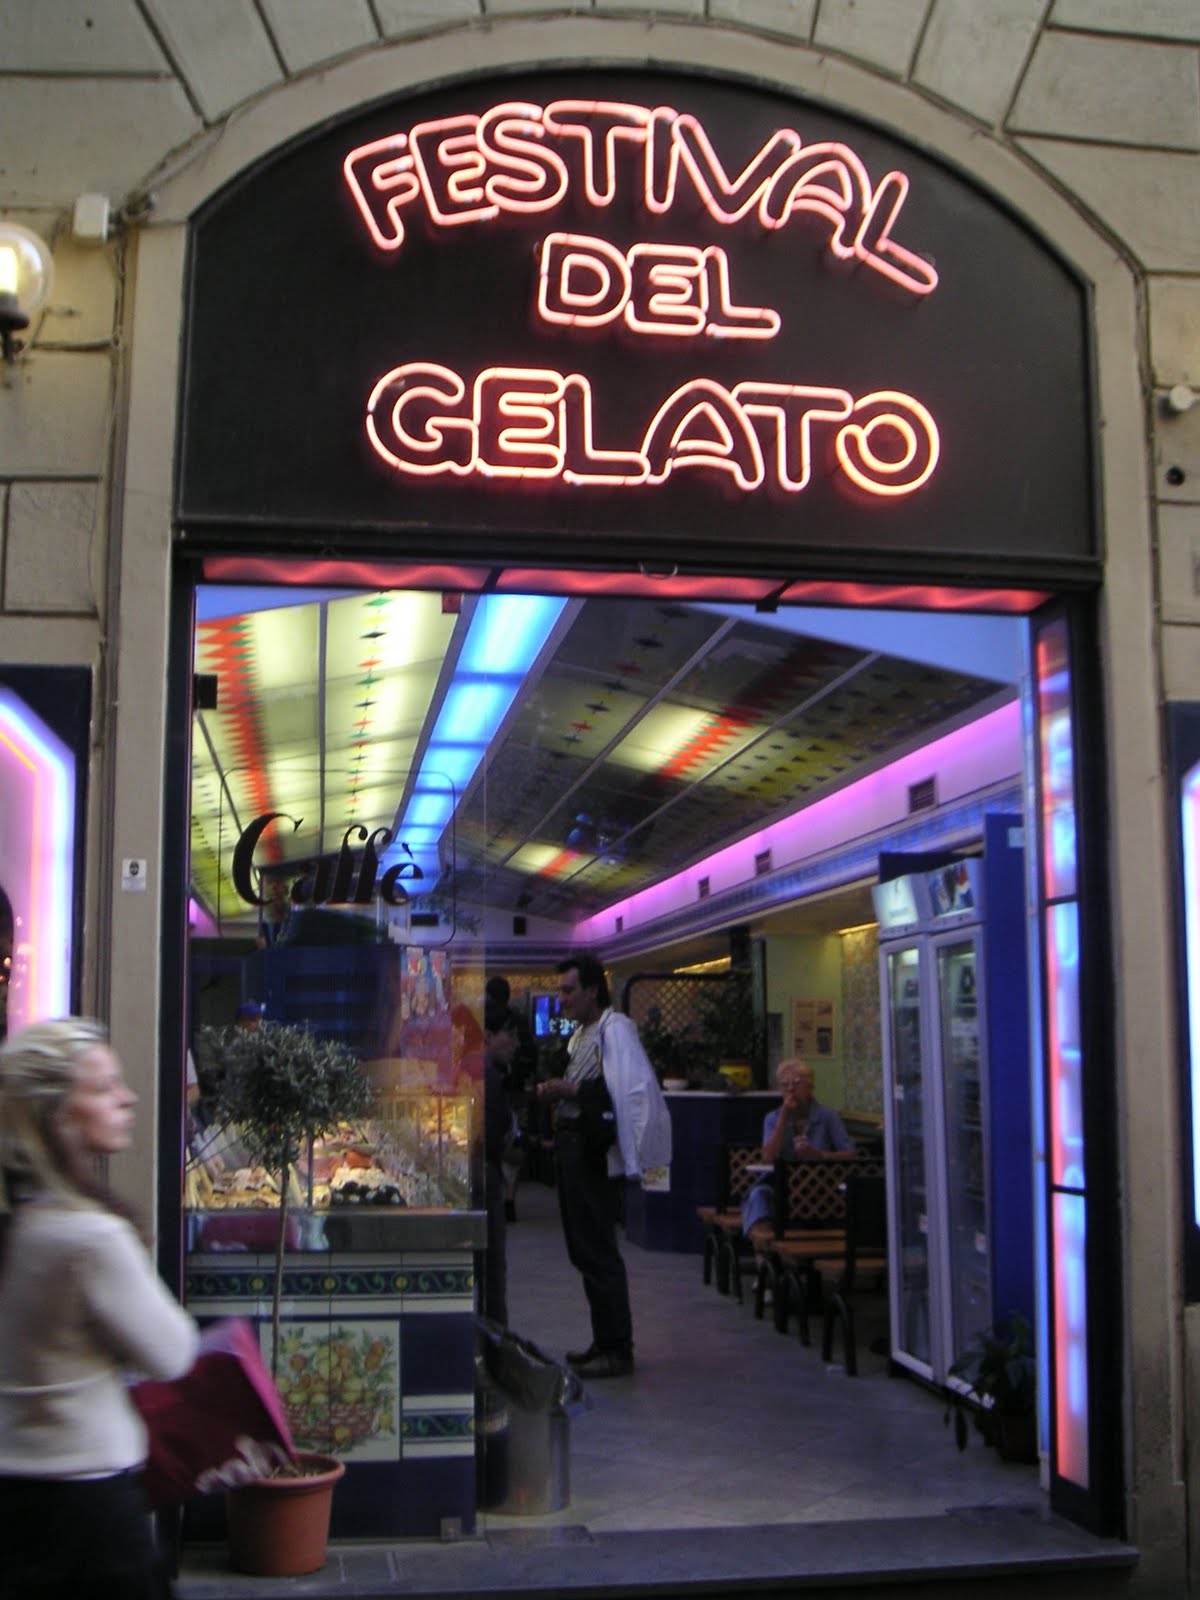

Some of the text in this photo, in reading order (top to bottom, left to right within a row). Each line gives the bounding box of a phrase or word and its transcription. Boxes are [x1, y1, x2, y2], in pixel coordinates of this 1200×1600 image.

[343, 99, 939, 295] FESTIVAL
[538, 232, 782, 340] DEL
[366, 362, 940, 496] GELATO
